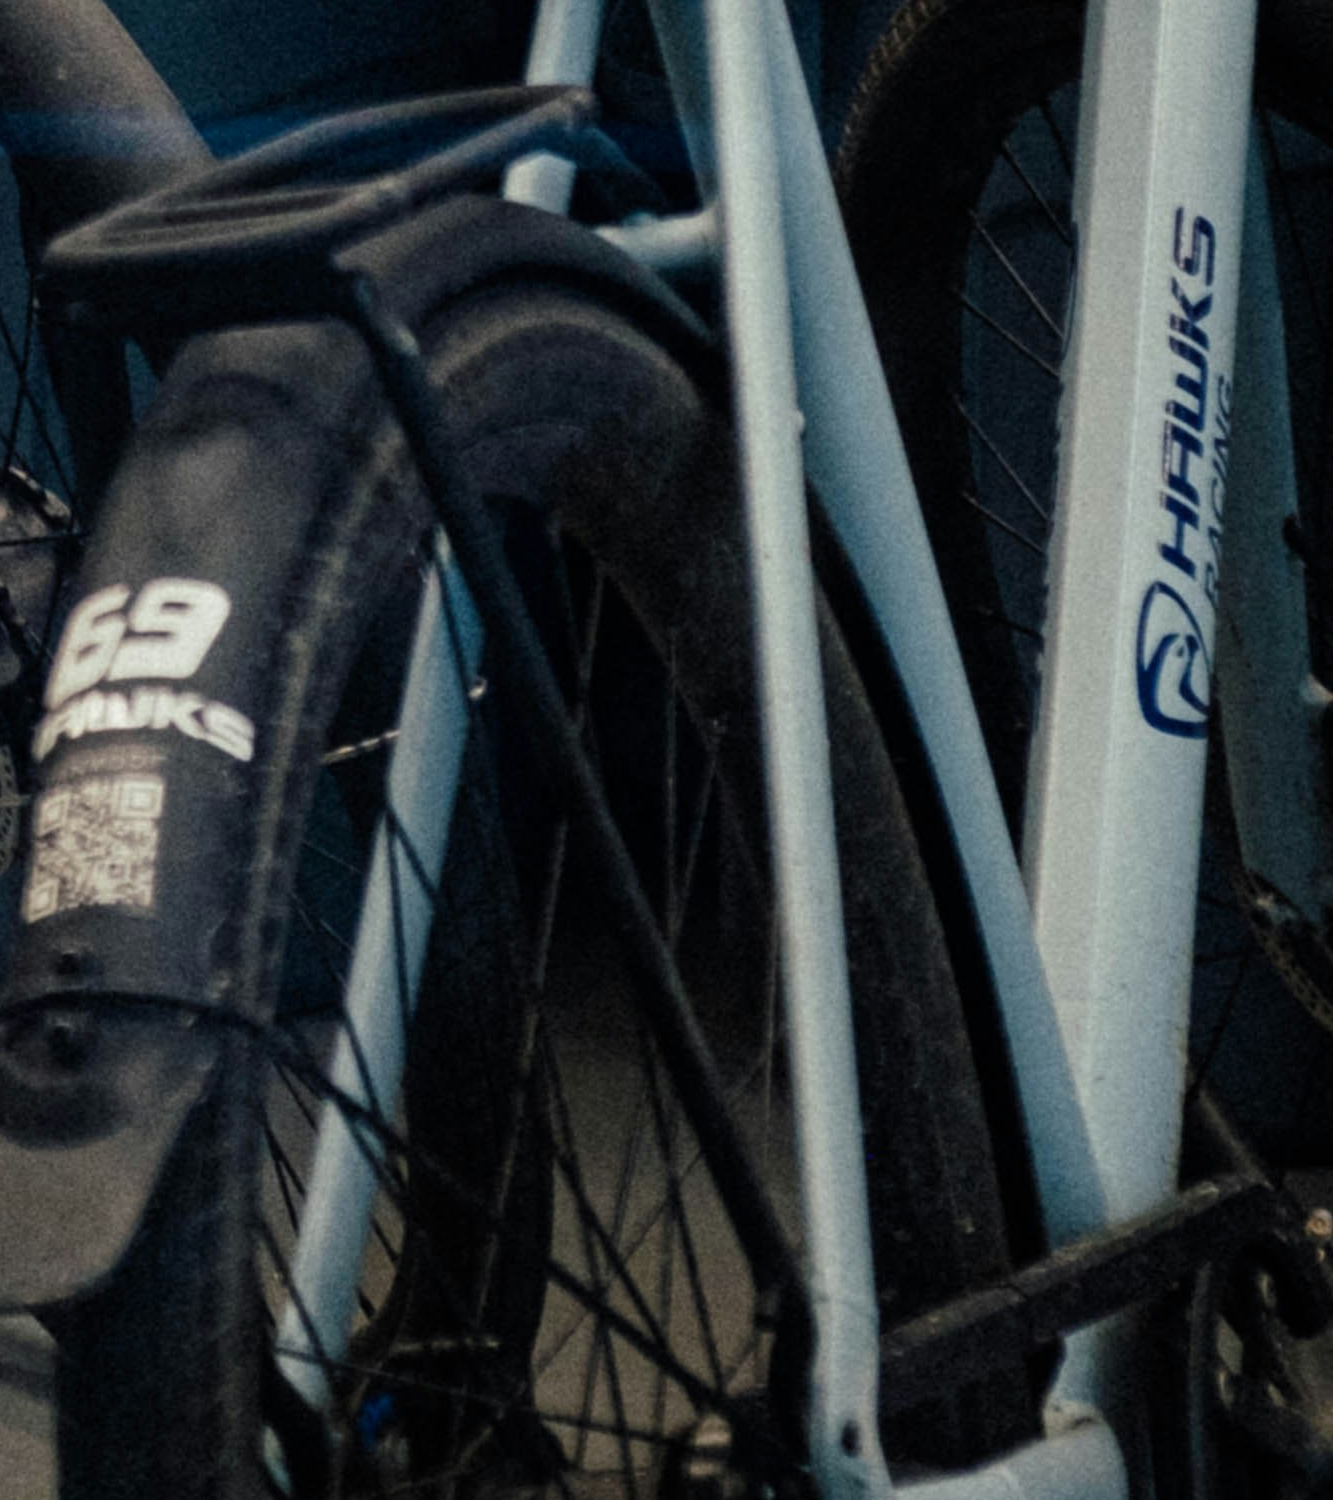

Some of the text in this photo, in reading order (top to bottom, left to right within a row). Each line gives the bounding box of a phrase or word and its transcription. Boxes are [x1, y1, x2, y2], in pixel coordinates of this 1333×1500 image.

[1158, 206, 1217, 578] HAWKS
[42, 576, 231, 712] 69
[31, 684, 256, 762] HAWKS
